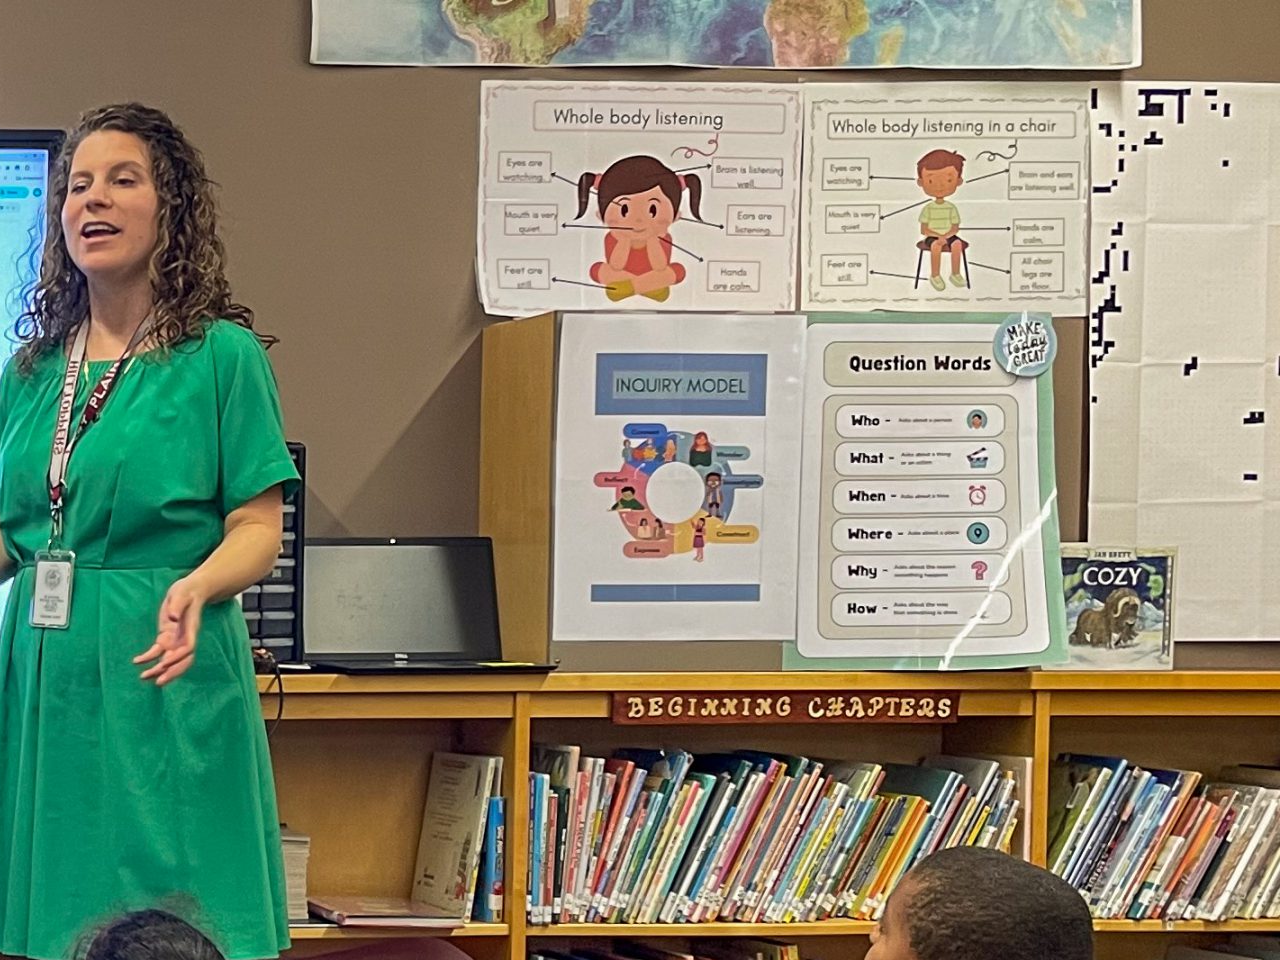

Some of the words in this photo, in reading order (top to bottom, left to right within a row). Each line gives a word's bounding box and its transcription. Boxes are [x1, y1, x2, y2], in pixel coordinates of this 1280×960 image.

[554, 108, 604, 124] Whole
[610, 108, 651, 129] body
[655, 109, 724, 130] listening
[832, 120, 877, 133] Whole
[882, 120, 919, 136] body
[922, 120, 984, 135] listening
[988, 120, 1001, 132] in
[1005, 121, 1015, 132] a
[1019, 119, 1057, 132] chair
[1006, 320, 1042, 341] MAKE
[849, 354, 927, 373] Question
[933, 355, 992, 371] Words
[1013, 350, 1045, 367] GREAT
[615, 377, 682, 393] INQUIRY
[687, 377, 746, 394] MODEL
[851, 414, 880, 427] Who
[849, 452, 884, 464] What
[848, 489, 886, 502] When
[847, 527, 893, 540] Where
[847, 564, 878, 579] Why
[1082, 566, 1143, 586] COZY
[847, 602, 877, 614] How
[626, 695, 793, 719] BEGINNING
[807, 696, 952, 719] CHAPTERS
